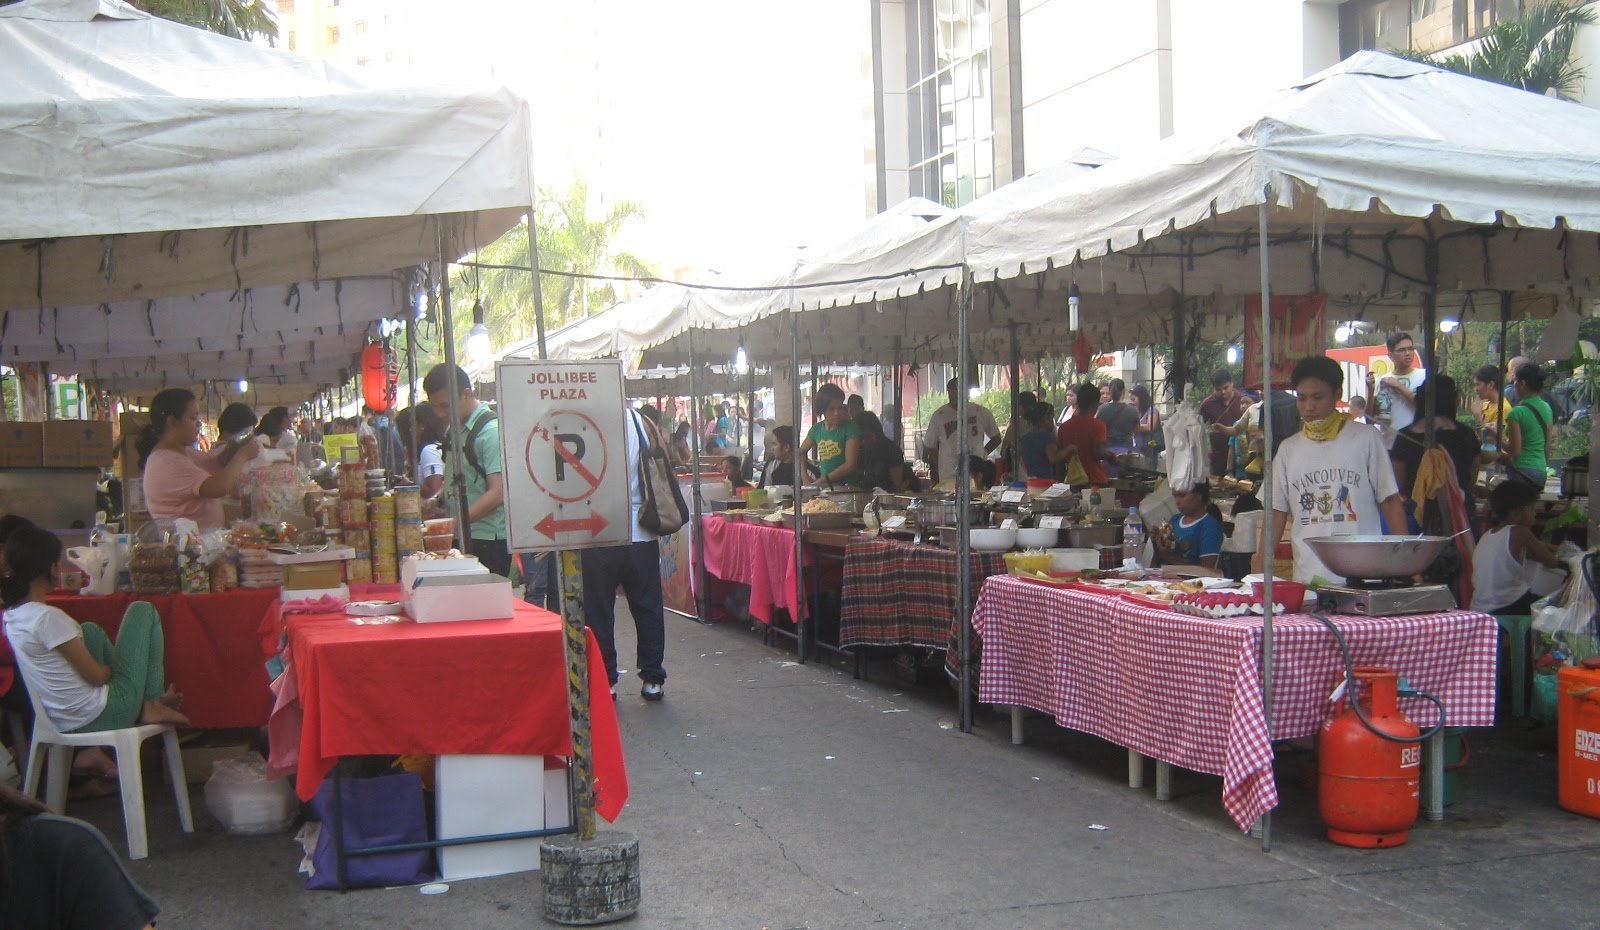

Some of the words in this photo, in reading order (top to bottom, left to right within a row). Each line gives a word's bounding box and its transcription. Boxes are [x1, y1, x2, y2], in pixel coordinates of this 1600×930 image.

[527, 371, 597, 385] JOLLIBEE
[540, 388, 588, 400] PLAZA
[1292, 468, 1361, 492] VANCOUVER
